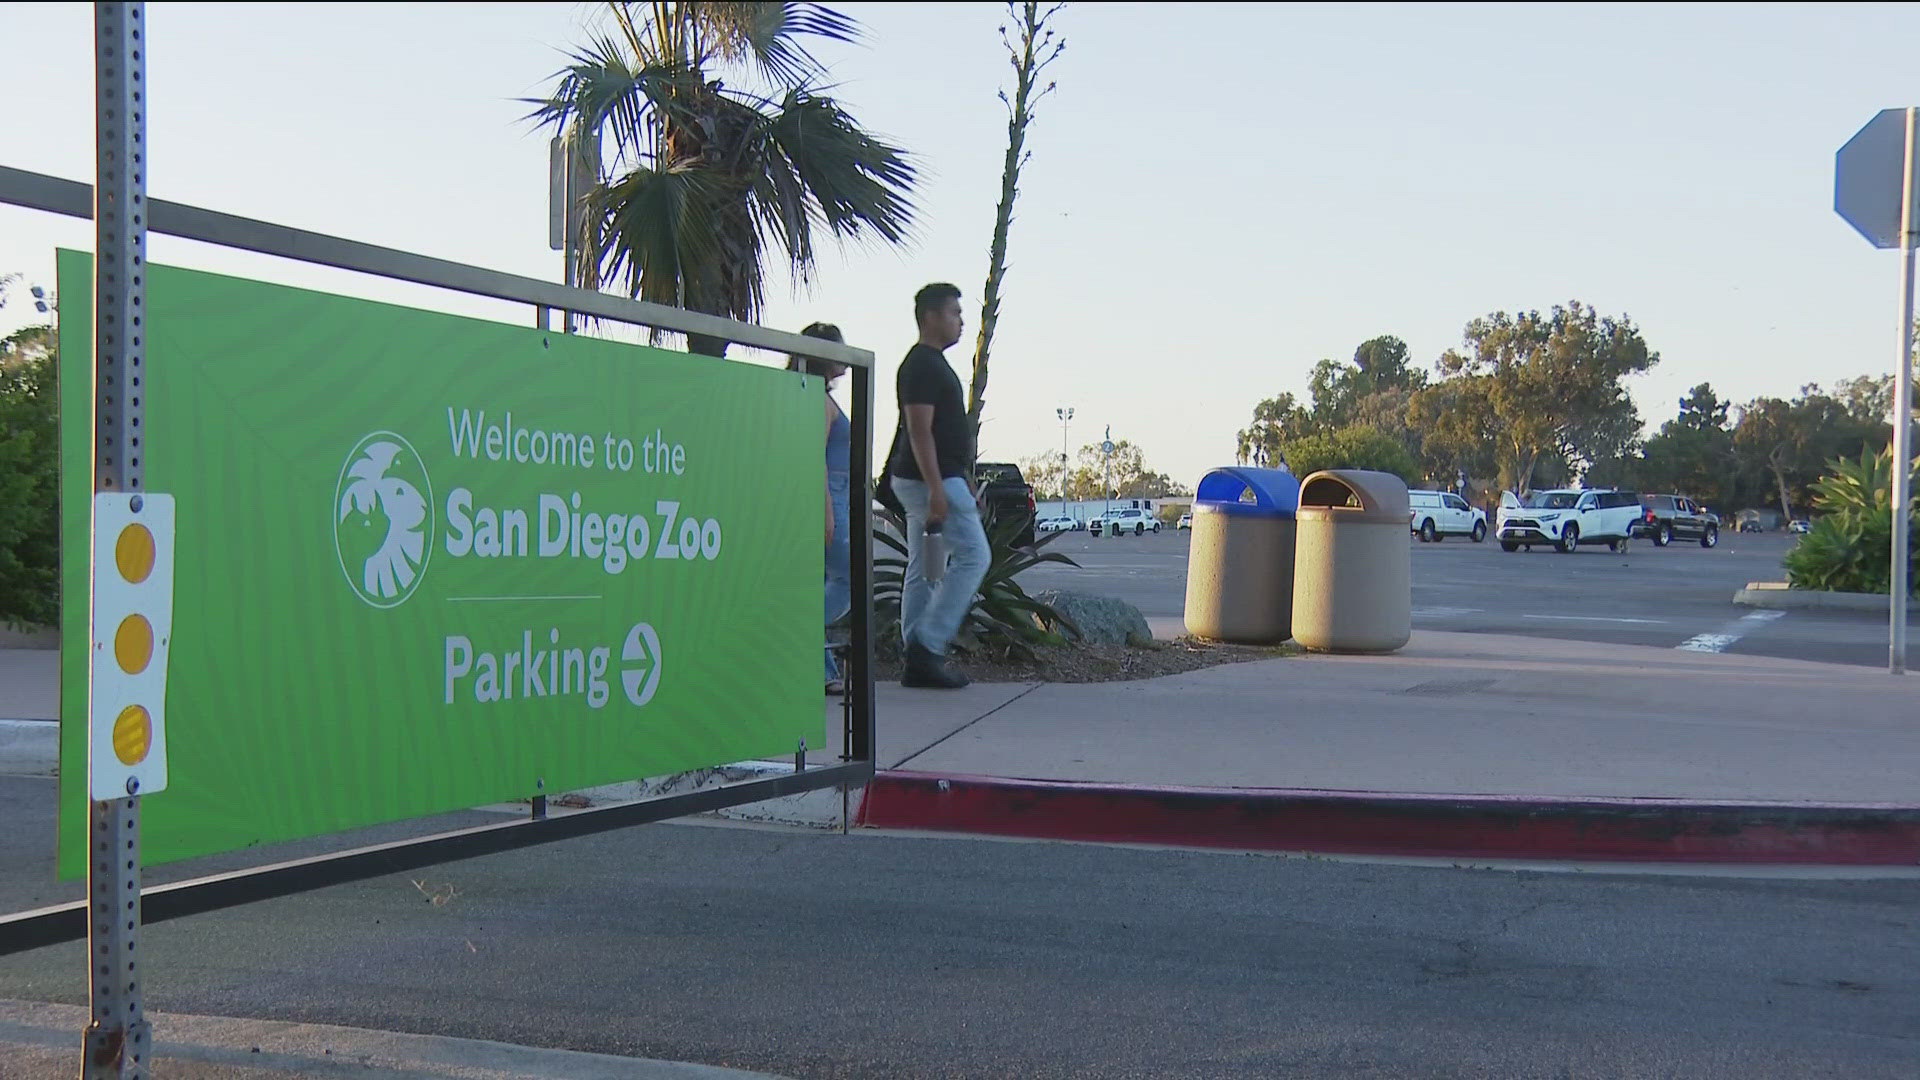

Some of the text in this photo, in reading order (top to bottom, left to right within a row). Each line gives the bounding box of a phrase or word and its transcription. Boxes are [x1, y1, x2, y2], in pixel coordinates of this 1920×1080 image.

[447, 407, 686, 476] Welcome to the
[446, 487, 723, 575] San Diego Zoo
[444, 627, 611, 709] Parking
